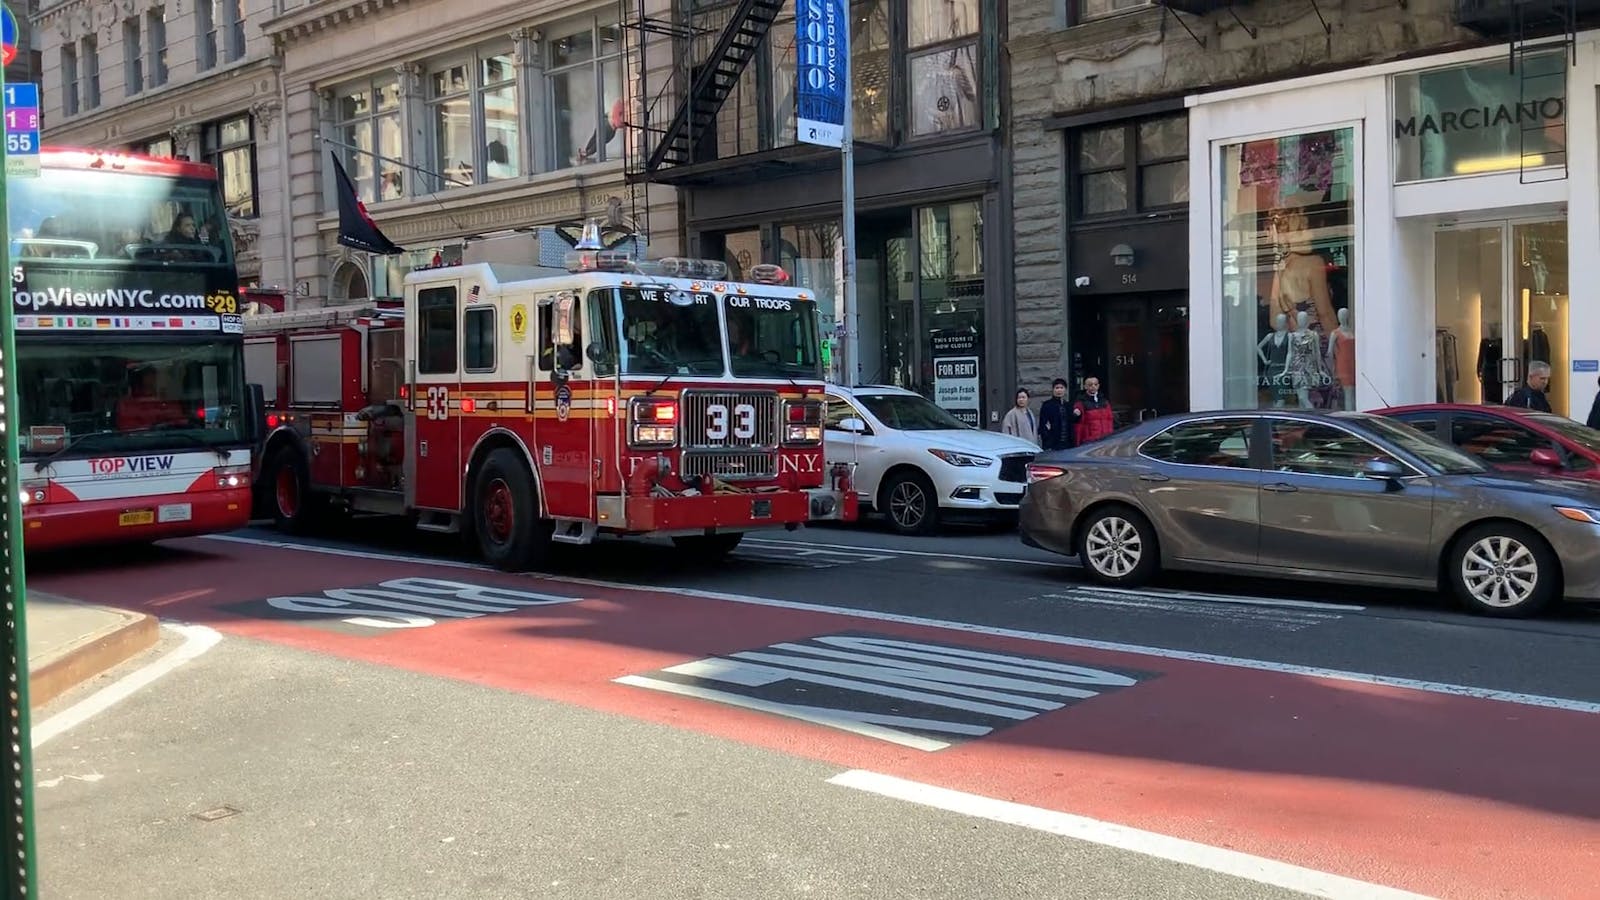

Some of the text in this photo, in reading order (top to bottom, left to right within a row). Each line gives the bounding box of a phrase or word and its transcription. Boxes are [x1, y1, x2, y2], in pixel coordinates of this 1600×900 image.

[826, 2, 836, 92] BROADWAY
[5, 87, 16, 104] 1
[6, 111, 17, 128] 1
[1394, 97, 1564, 139] MARCIANO
[7, 133, 31, 151] 55
[11, 266, 24, 283] 5
[1121, 274, 1137, 285] 514
[207, 295, 237, 314] $29
[640, 290, 658, 302] WE
[729, 296, 791, 311] OUR TROOPS
[1116, 355, 1134, 365] 514
[938, 363, 975, 376] FOR RENT
[427, 386, 448, 420] 33
[706, 404, 755, 440] 33
[780, 454, 821, 473] N.Y.
[611, 635, 1138, 753] ONLY
